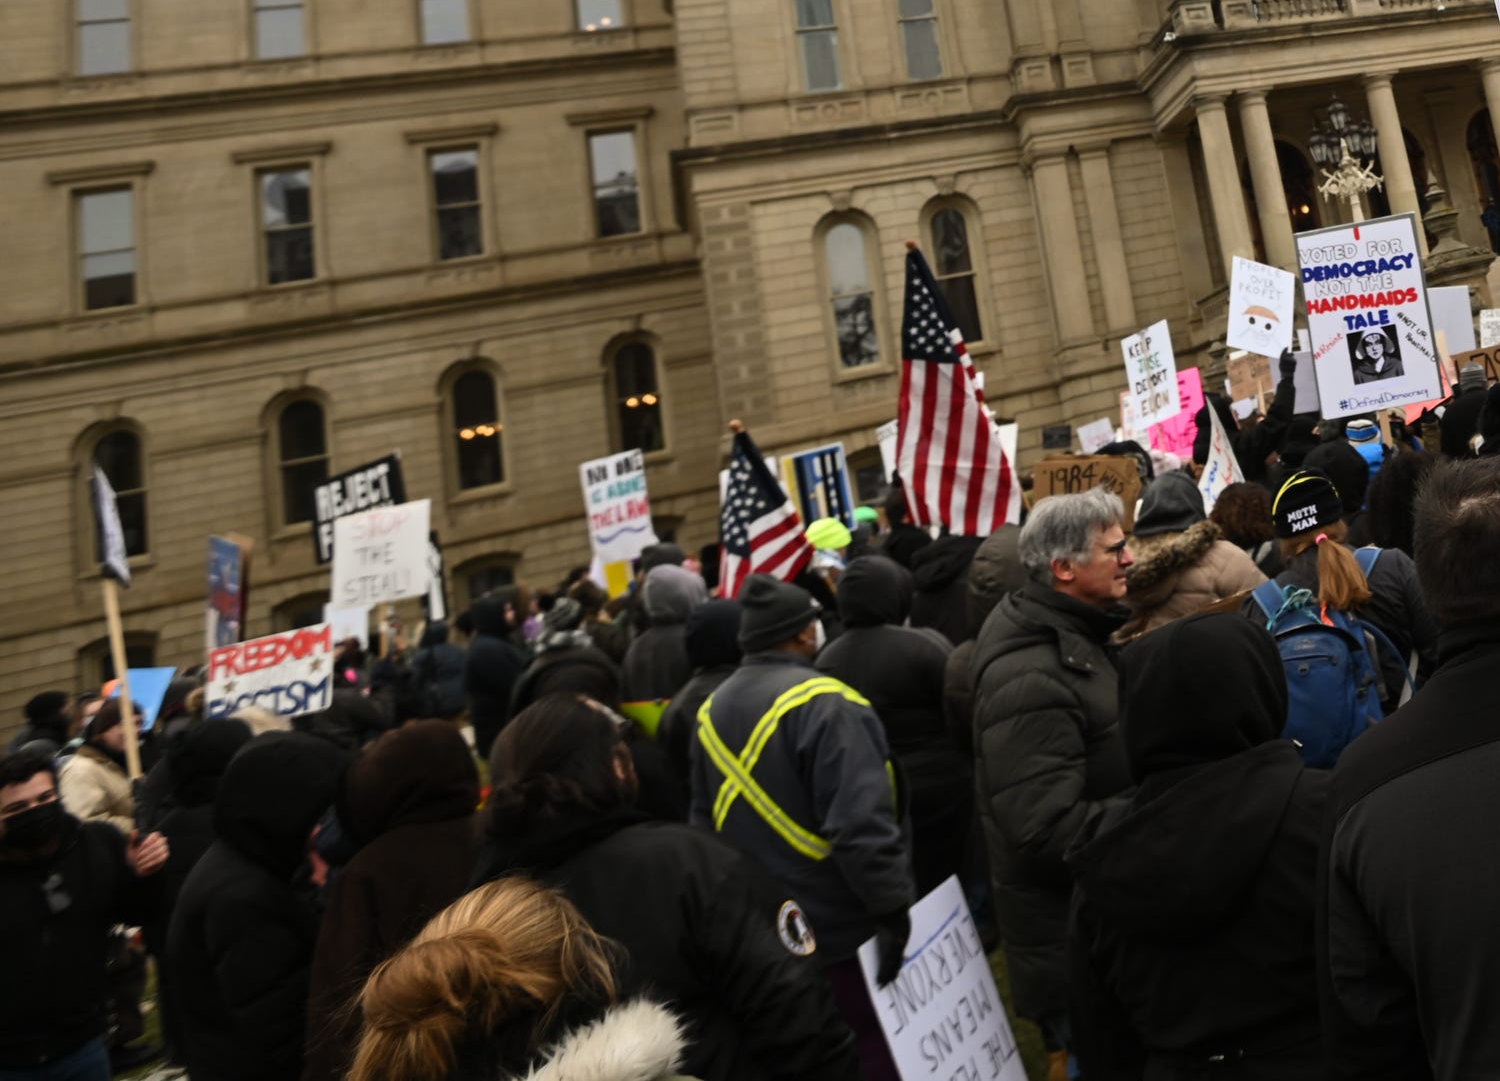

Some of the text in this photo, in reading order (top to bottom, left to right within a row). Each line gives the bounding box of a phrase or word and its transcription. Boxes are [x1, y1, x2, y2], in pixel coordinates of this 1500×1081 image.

[1299, 238, 1404, 264] VOTED FOR
[1301, 252, 1415, 283] DEMOCRACY
[1238, 283, 1283, 301] PROFIT
[1314, 273, 1394, 298] NOT THE
[1306, 287, 1418, 315] HANDMAIDS
[1343, 309, 1390, 331] TALE
[1135, 368, 1168, 396] DEORT
[314, 463, 392, 521] REJECT
[1050, 463, 1096, 495] 1984
[1287, 504, 1318, 523] MOTH
[1291, 516, 1318, 533] MAN
[353, 541, 395, 567] THE
[208, 625, 332, 681] FREEDOM
[888, 914, 984, 1036] EVERYONE
[919, 979, 993, 1074] MEANS
